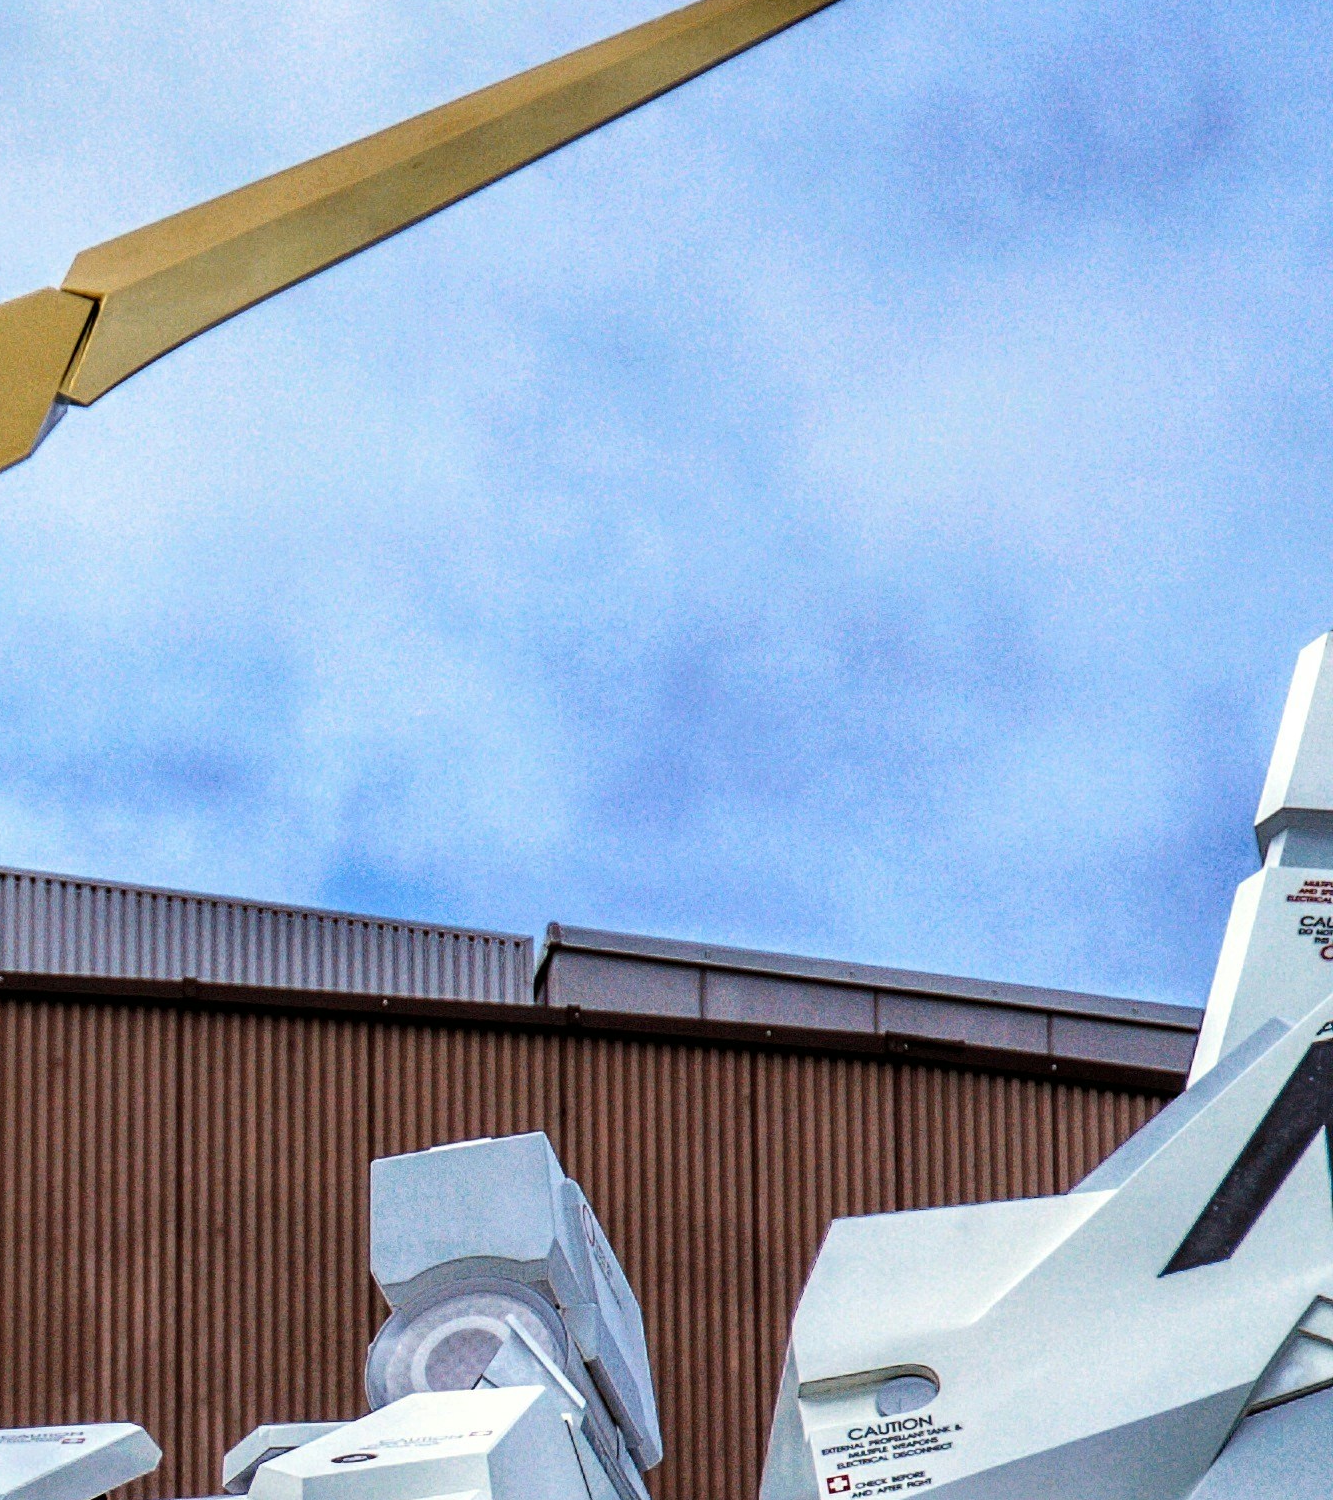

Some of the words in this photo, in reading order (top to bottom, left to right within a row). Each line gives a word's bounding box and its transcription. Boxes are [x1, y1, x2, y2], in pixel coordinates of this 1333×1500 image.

[848, 1415, 933, 1440] CAUTION
[821, 1442, 865, 1456] EXTERNAL
[927, 1426, 951, 1435] TANK
[892, 1436, 938, 1450] WEAPONS
[855, 1478, 888, 1489] CHECK
[892, 1471, 925, 1482] BEFORE
[877, 1484, 902, 1494] AFTER
